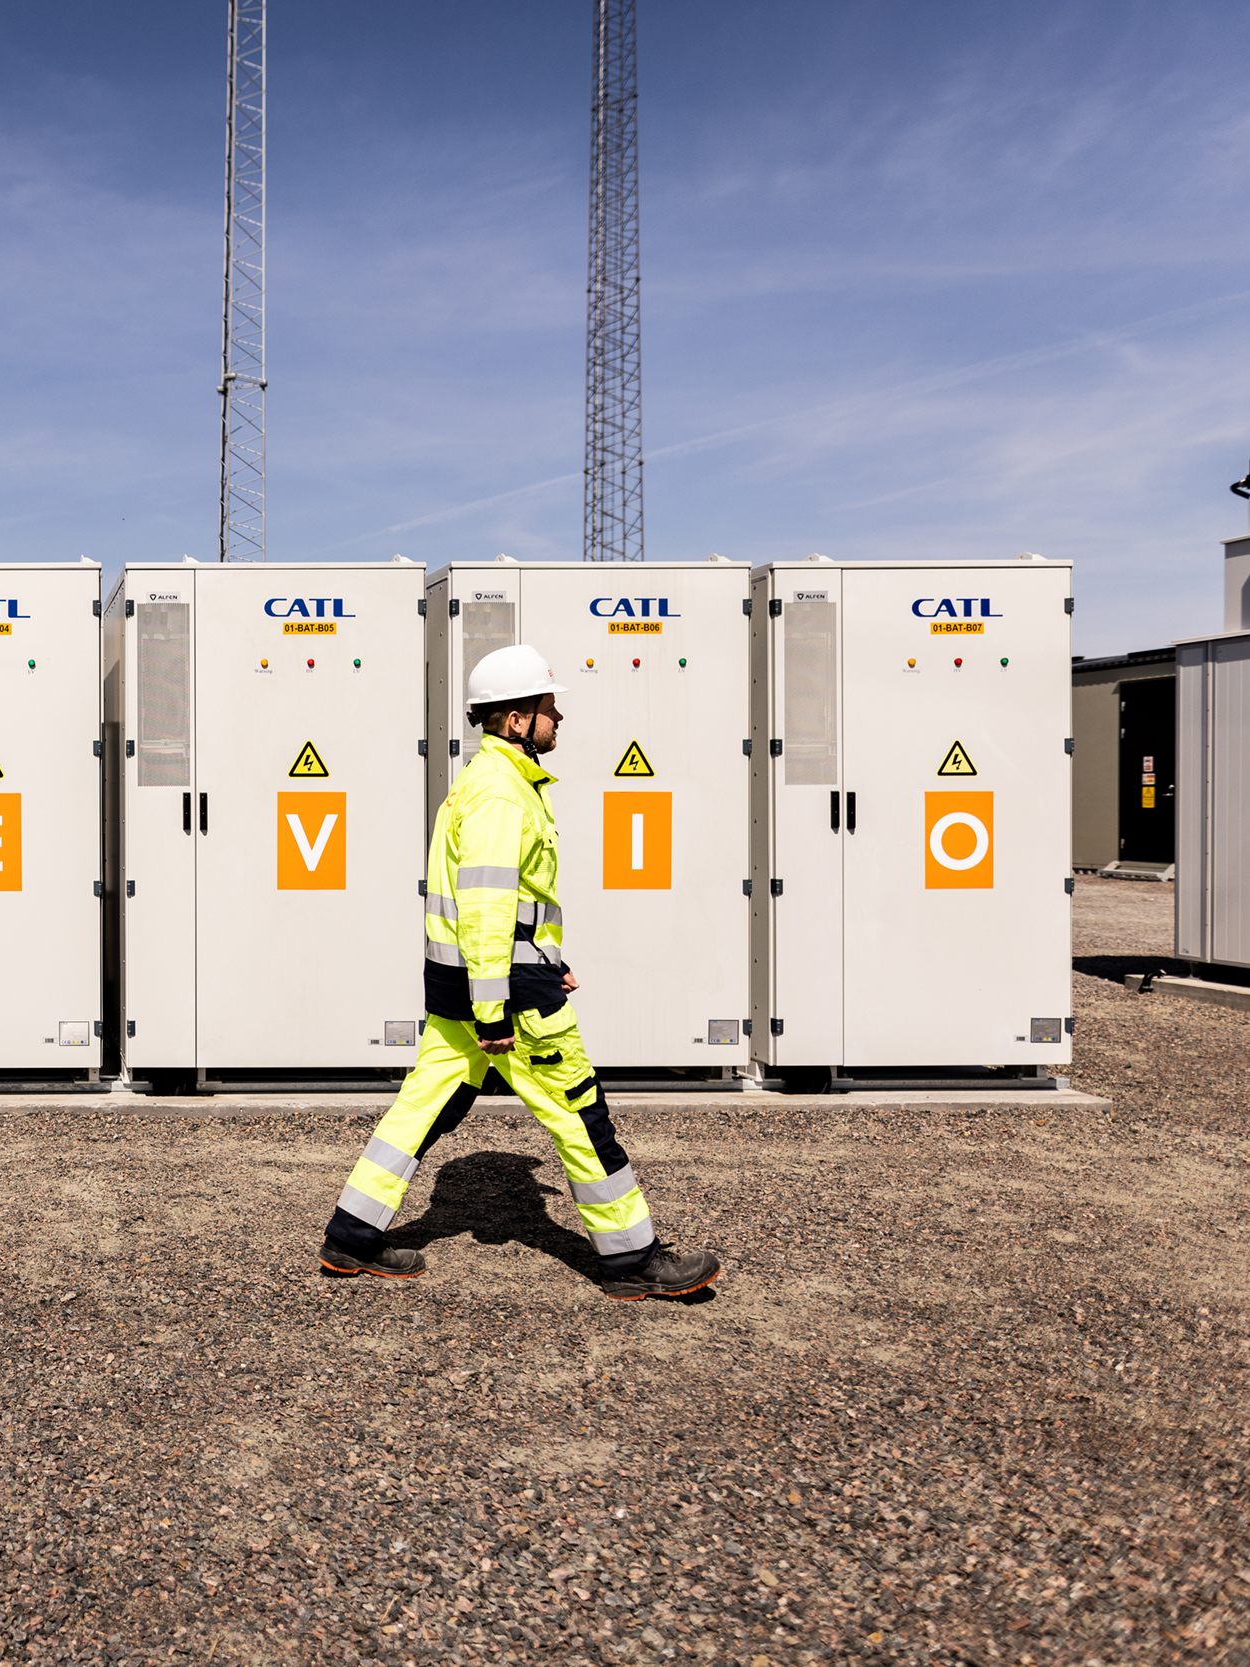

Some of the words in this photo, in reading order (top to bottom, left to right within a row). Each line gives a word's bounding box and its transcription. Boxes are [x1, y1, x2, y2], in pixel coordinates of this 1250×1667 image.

[264, 599, 355, 617] CATL
[590, 598, 681, 616] CATL
[912, 599, 1003, 617] CATL
[284, 624, 334, 633] 01-BAT-B05
[610, 623, 660, 632] 01-BAT-B06
[932, 623, 982, 632] 01-BAT-B07
[286, 814, 338, 871] V
[632, 814, 643, 869] I
[929, 811, 989, 871] O
